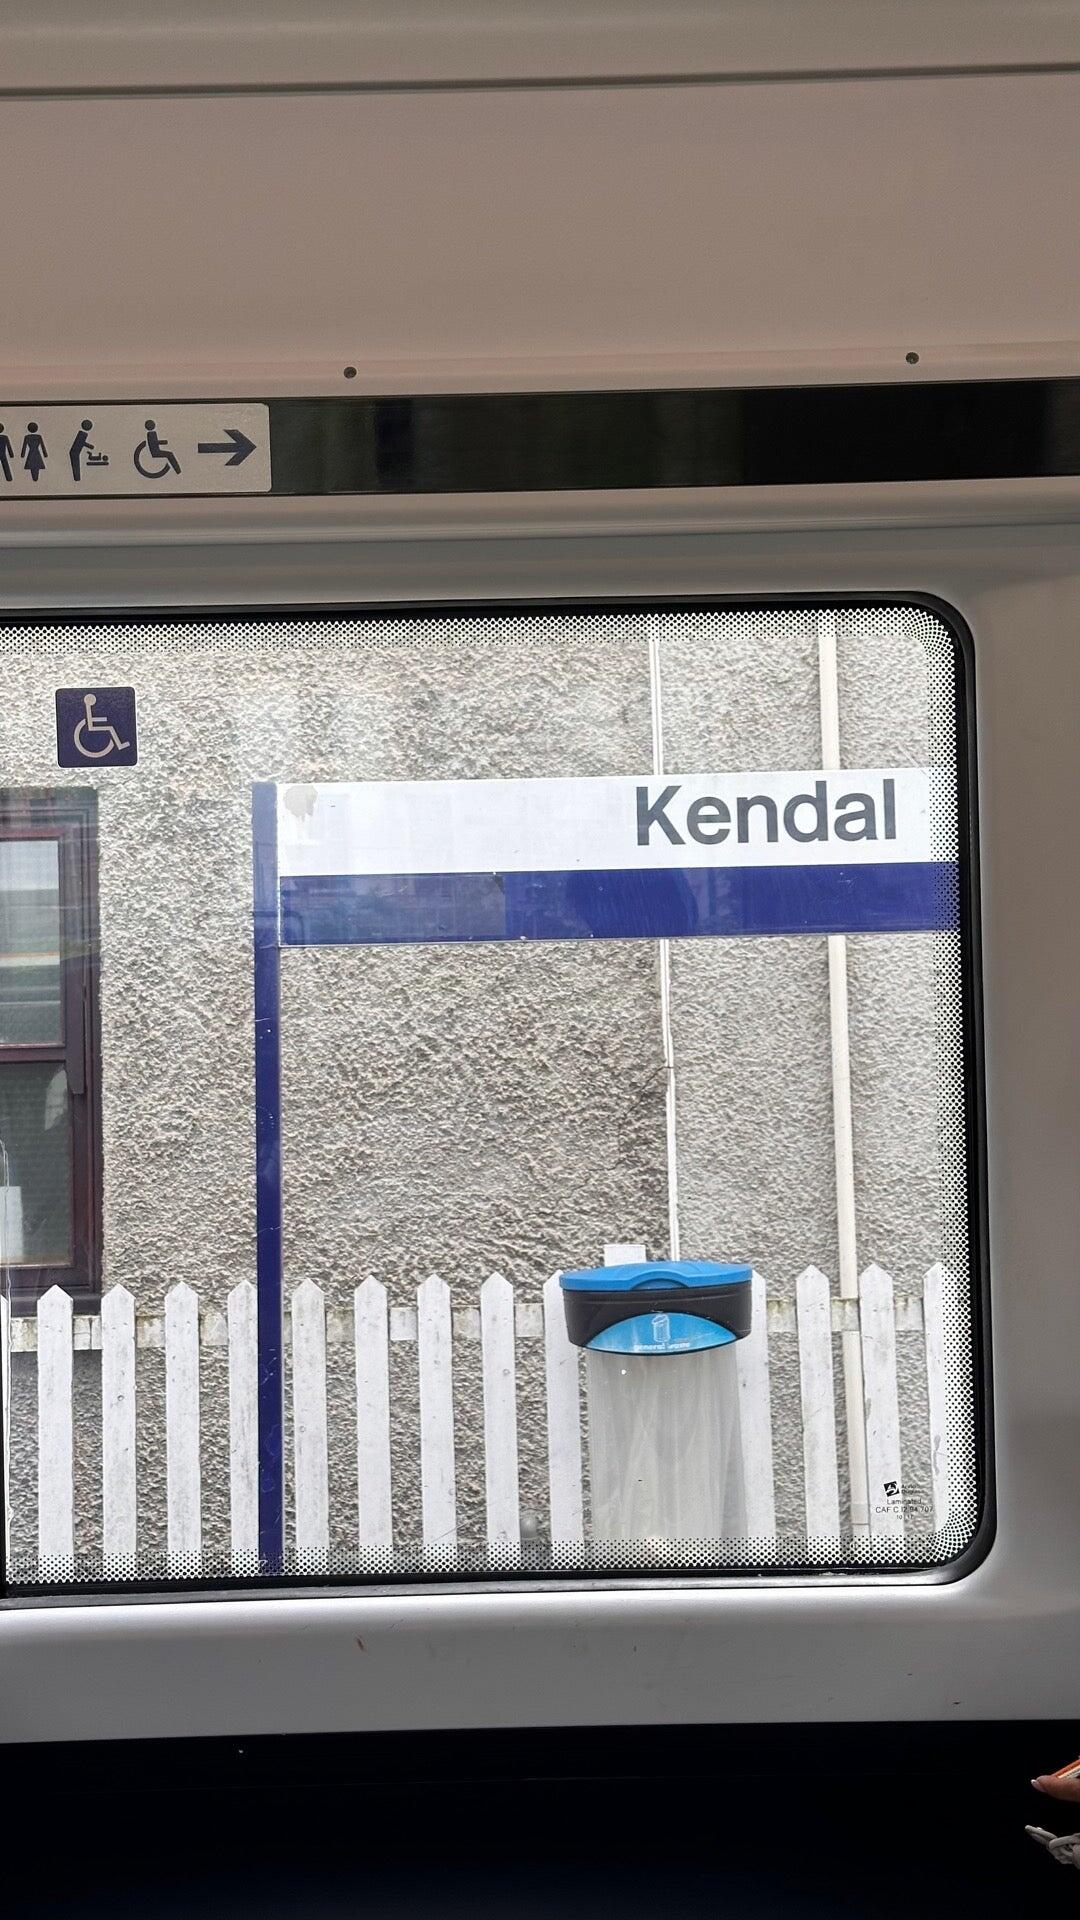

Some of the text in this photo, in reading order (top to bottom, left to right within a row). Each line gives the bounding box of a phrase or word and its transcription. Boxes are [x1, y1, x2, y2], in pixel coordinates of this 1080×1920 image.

[636, 778, 896, 846] Kendal
[634, 1342, 690, 1353] general waste
[875, 1505, 891, 1514] CAF
